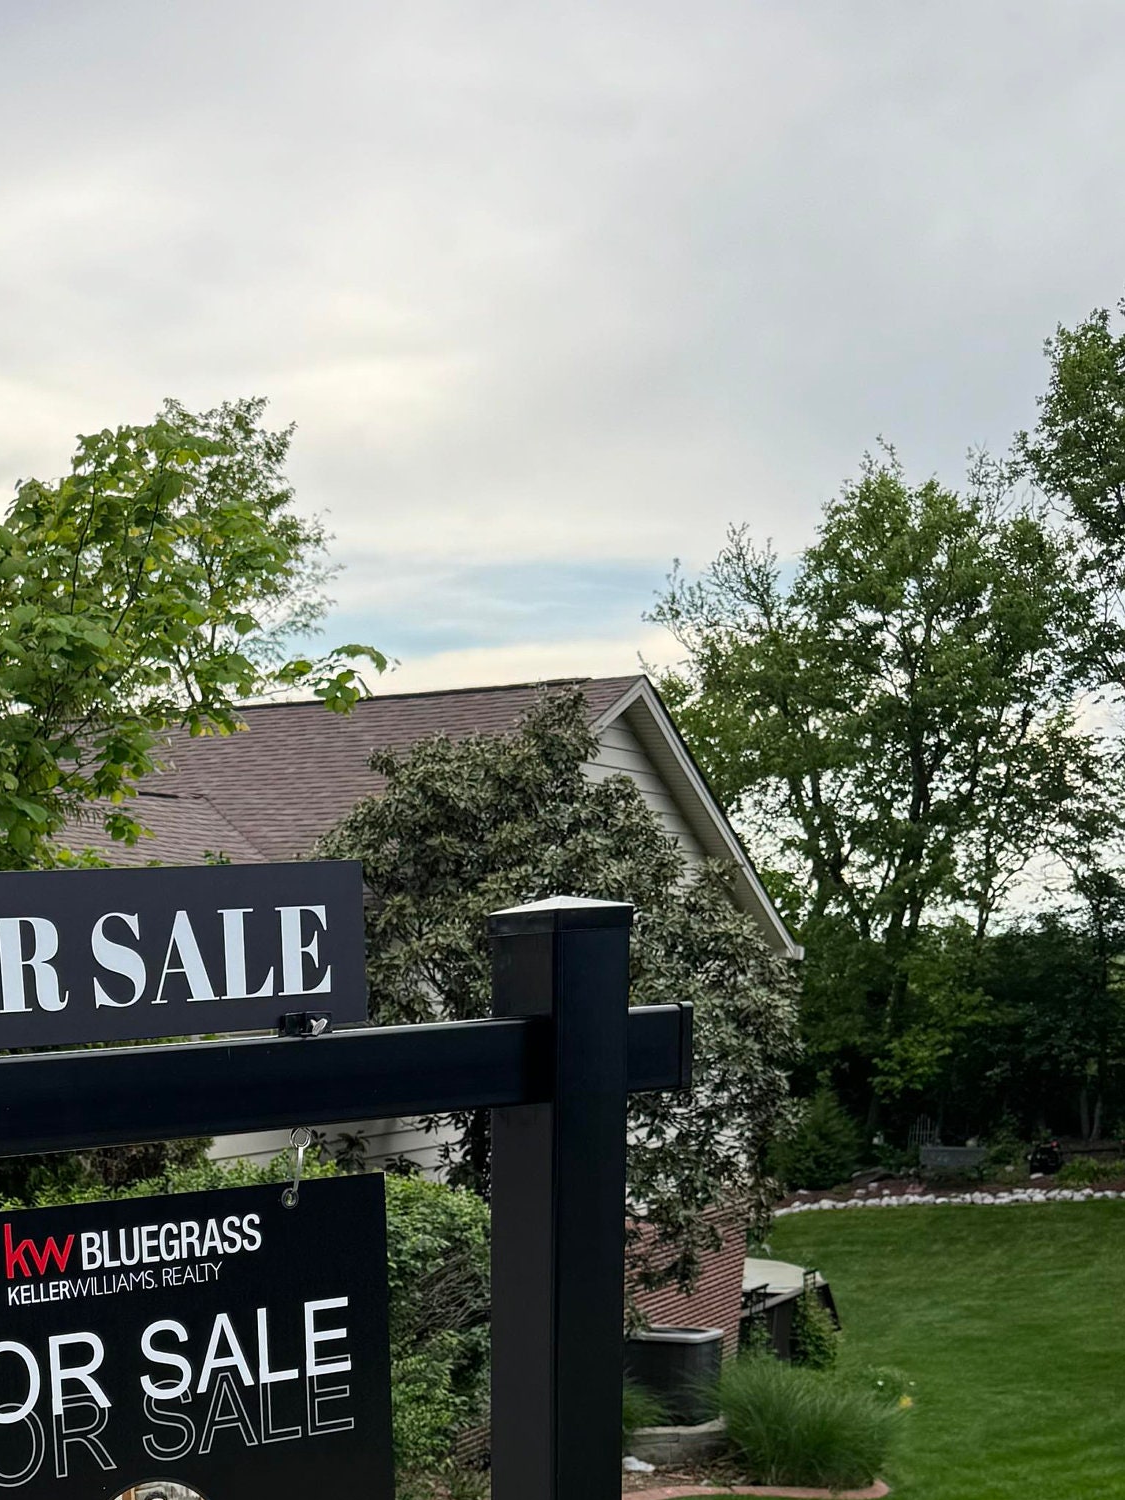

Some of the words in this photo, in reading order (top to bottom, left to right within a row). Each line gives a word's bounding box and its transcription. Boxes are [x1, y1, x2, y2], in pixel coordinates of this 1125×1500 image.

[90, 904, 332, 1009] SALE
[3, 1223, 75, 1279] kw
[80, 1213, 263, 1271] BLUEGRASS
[162, 1261, 223, 1287] REALTY
[139, 1296, 352, 1401] SALE
[141, 1355, 356, 1462] SALE
